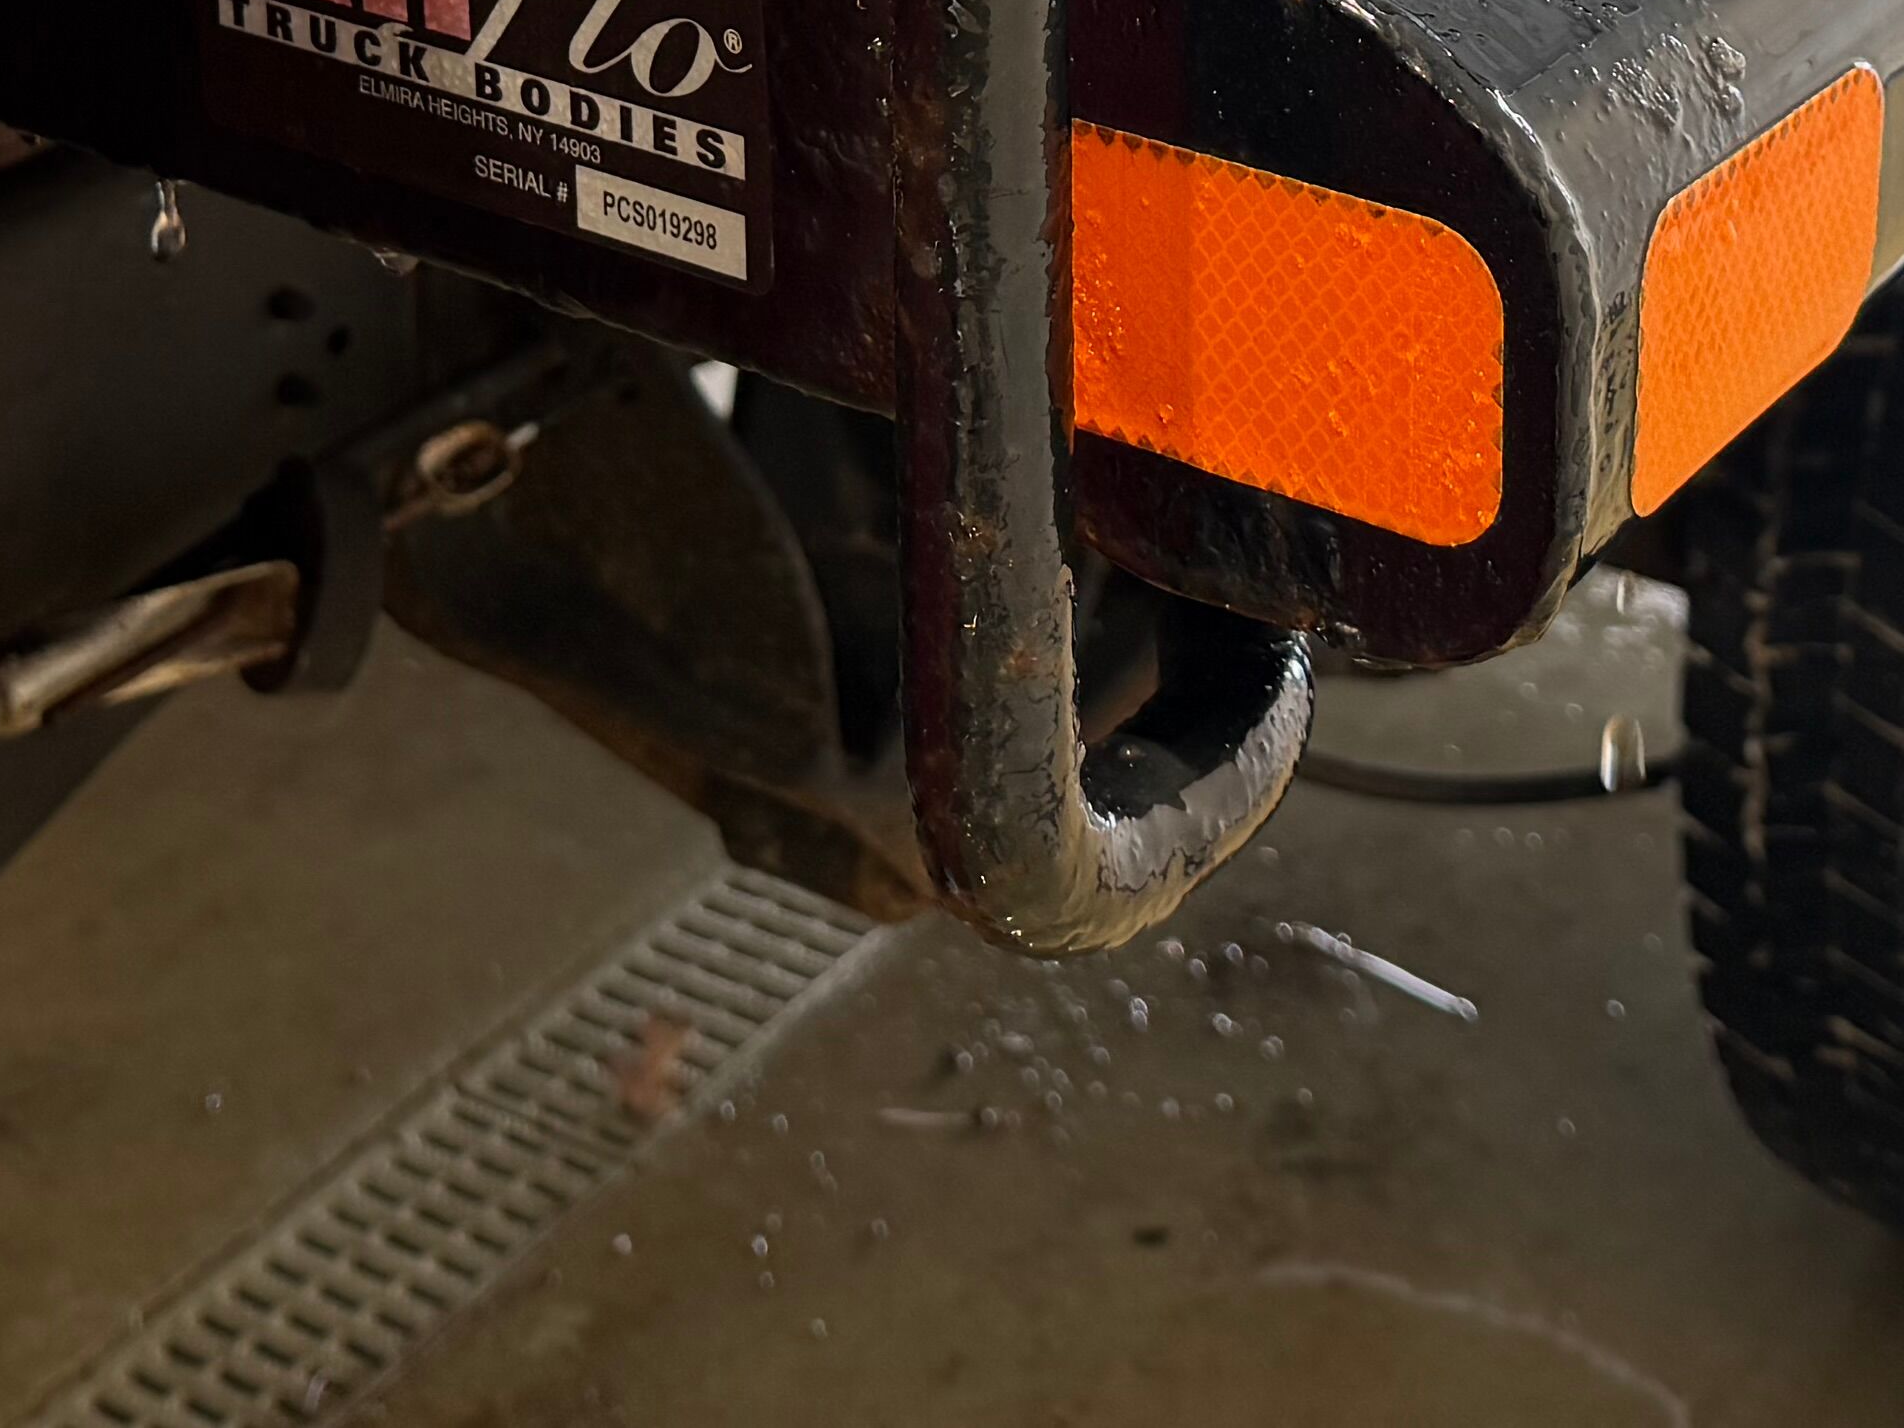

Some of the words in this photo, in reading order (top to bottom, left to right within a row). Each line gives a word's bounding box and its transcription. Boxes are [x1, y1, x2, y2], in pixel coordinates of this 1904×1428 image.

[359, 76, 425, 112] ELMIRA
[428, 92, 514, 140] HEIGHTS,
[518, 123, 544, 146] NY
[550, 130, 601, 164] 14903
[474, 62, 727, 170] BODIES
[474, 155, 551, 199] SERIAL
[557, 182, 570, 203] #
[602, 190, 717, 250] PCS019298
